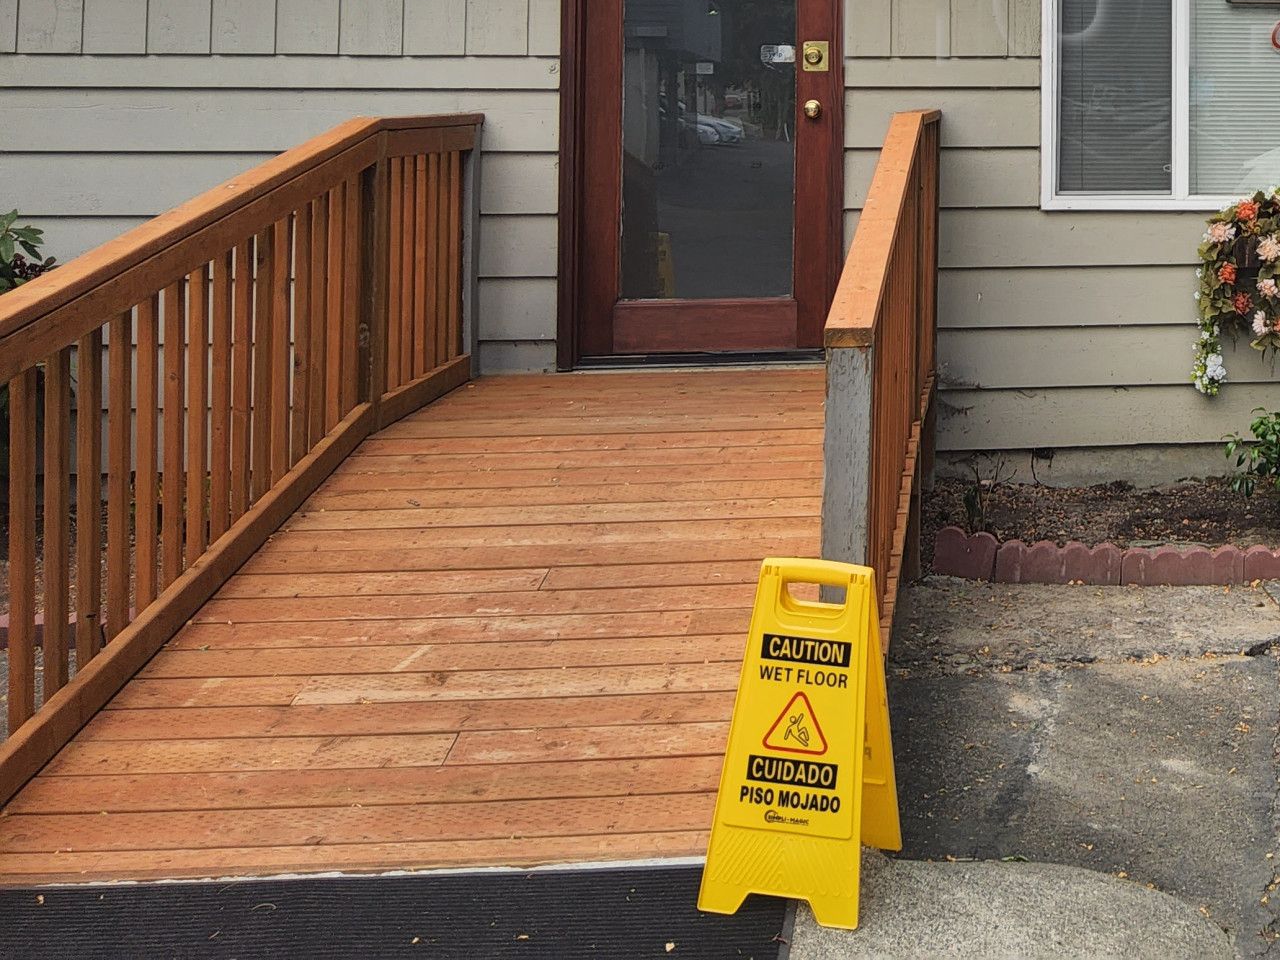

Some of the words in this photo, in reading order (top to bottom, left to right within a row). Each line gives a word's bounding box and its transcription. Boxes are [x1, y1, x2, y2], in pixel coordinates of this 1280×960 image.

[769, 637, 845, 664] CAUTION
[760, 665, 793, 682] WET
[797, 669, 848, 689] FLOOR
[752, 757, 833, 786] CUIDADO
[740, 785, 775, 806] PISO
[778, 790, 841, 813] MOJADO
